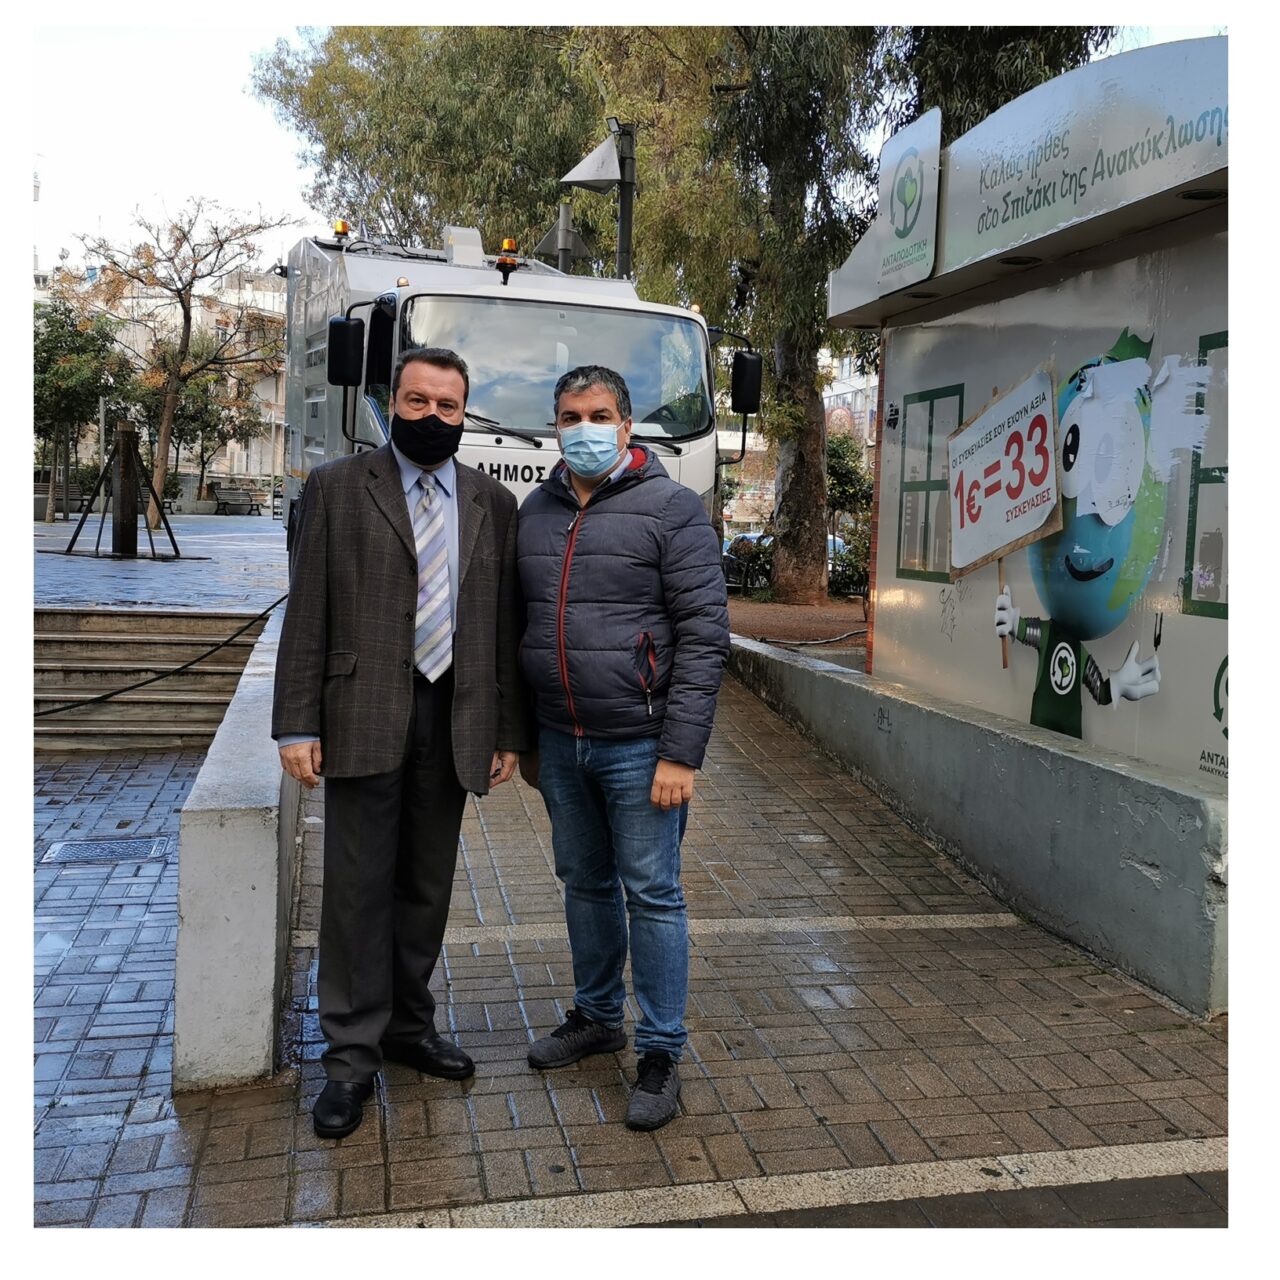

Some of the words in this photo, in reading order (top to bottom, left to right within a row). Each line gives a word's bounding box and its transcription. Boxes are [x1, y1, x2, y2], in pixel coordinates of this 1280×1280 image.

[1001, 179, 1056, 224] Σπιτάκι
[1060, 167, 1087, 205] της
[993, 423, 1006, 440] ΣΟΥ
[1007, 407, 1028, 429] ΕΧΟΥΝ
[1030, 391, 1047, 412] ΑΞΙΑ
[1006, 488, 1051, 523] ΣΥΣΚΕΥΑΣΙΕΣ
[1200, 749, 1228, 768] ΑΝΤΑ
